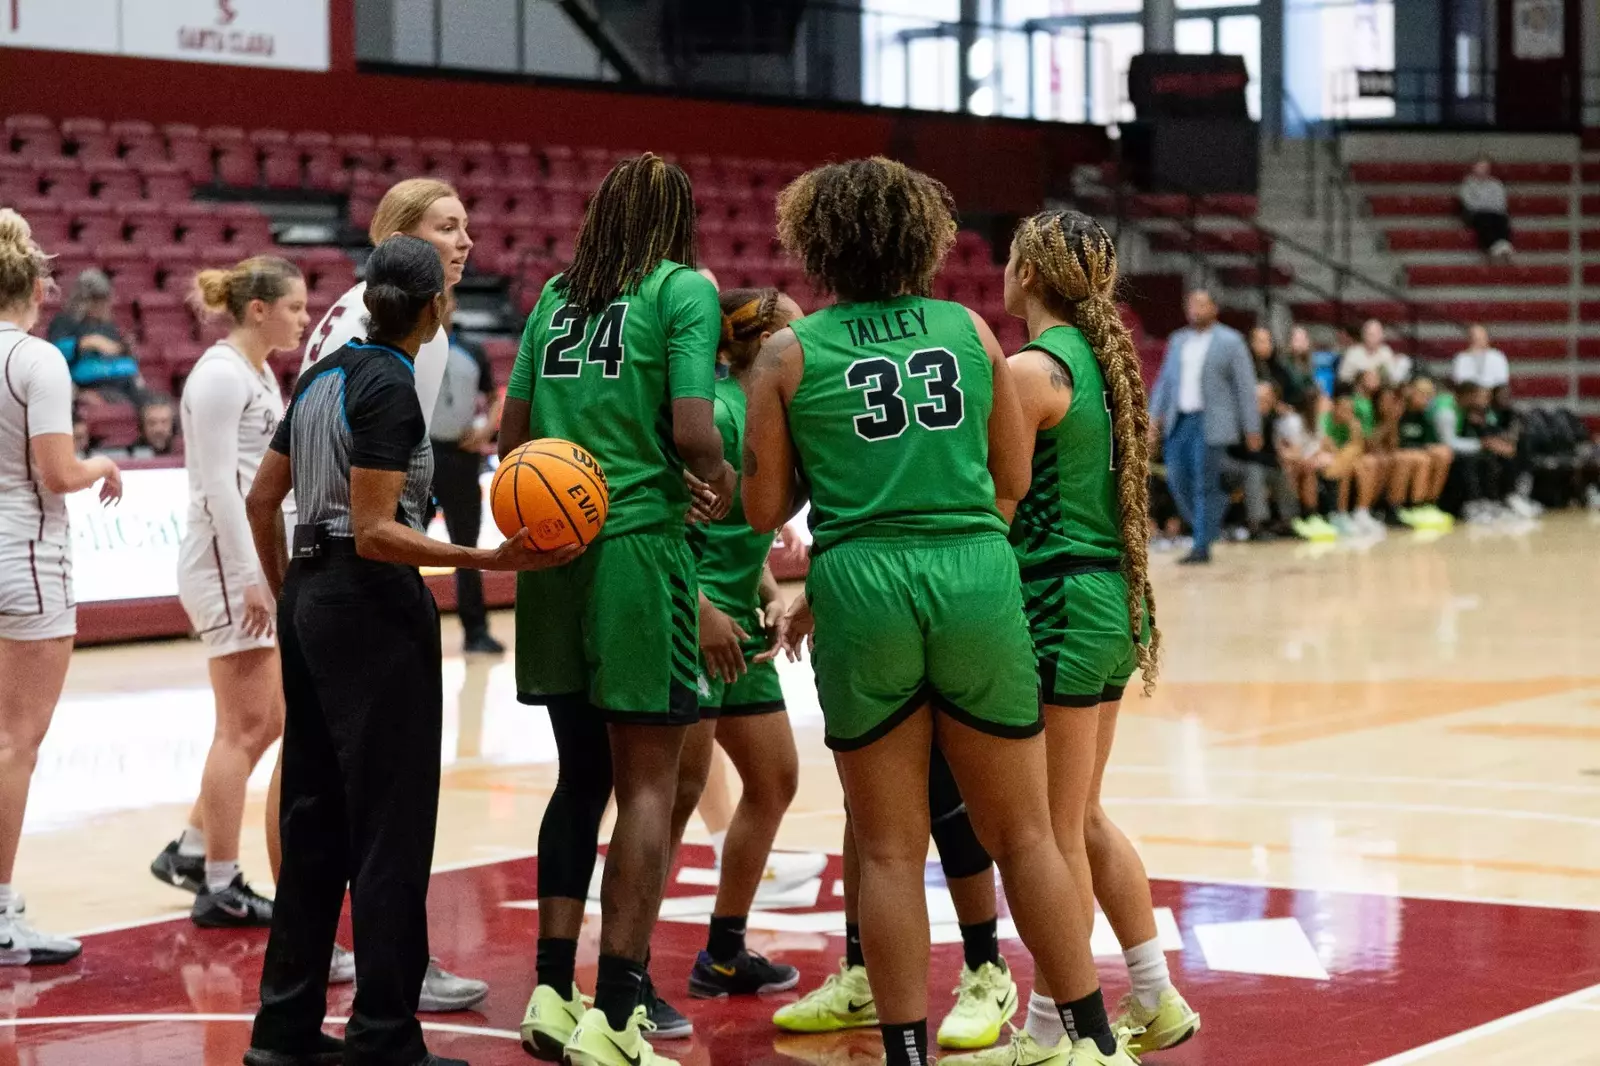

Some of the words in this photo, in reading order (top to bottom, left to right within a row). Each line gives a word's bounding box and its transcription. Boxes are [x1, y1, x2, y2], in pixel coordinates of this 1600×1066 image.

[541, 302, 629, 379] 24
[840, 307, 929, 347] TALLEY
[844, 346, 965, 443] 33
